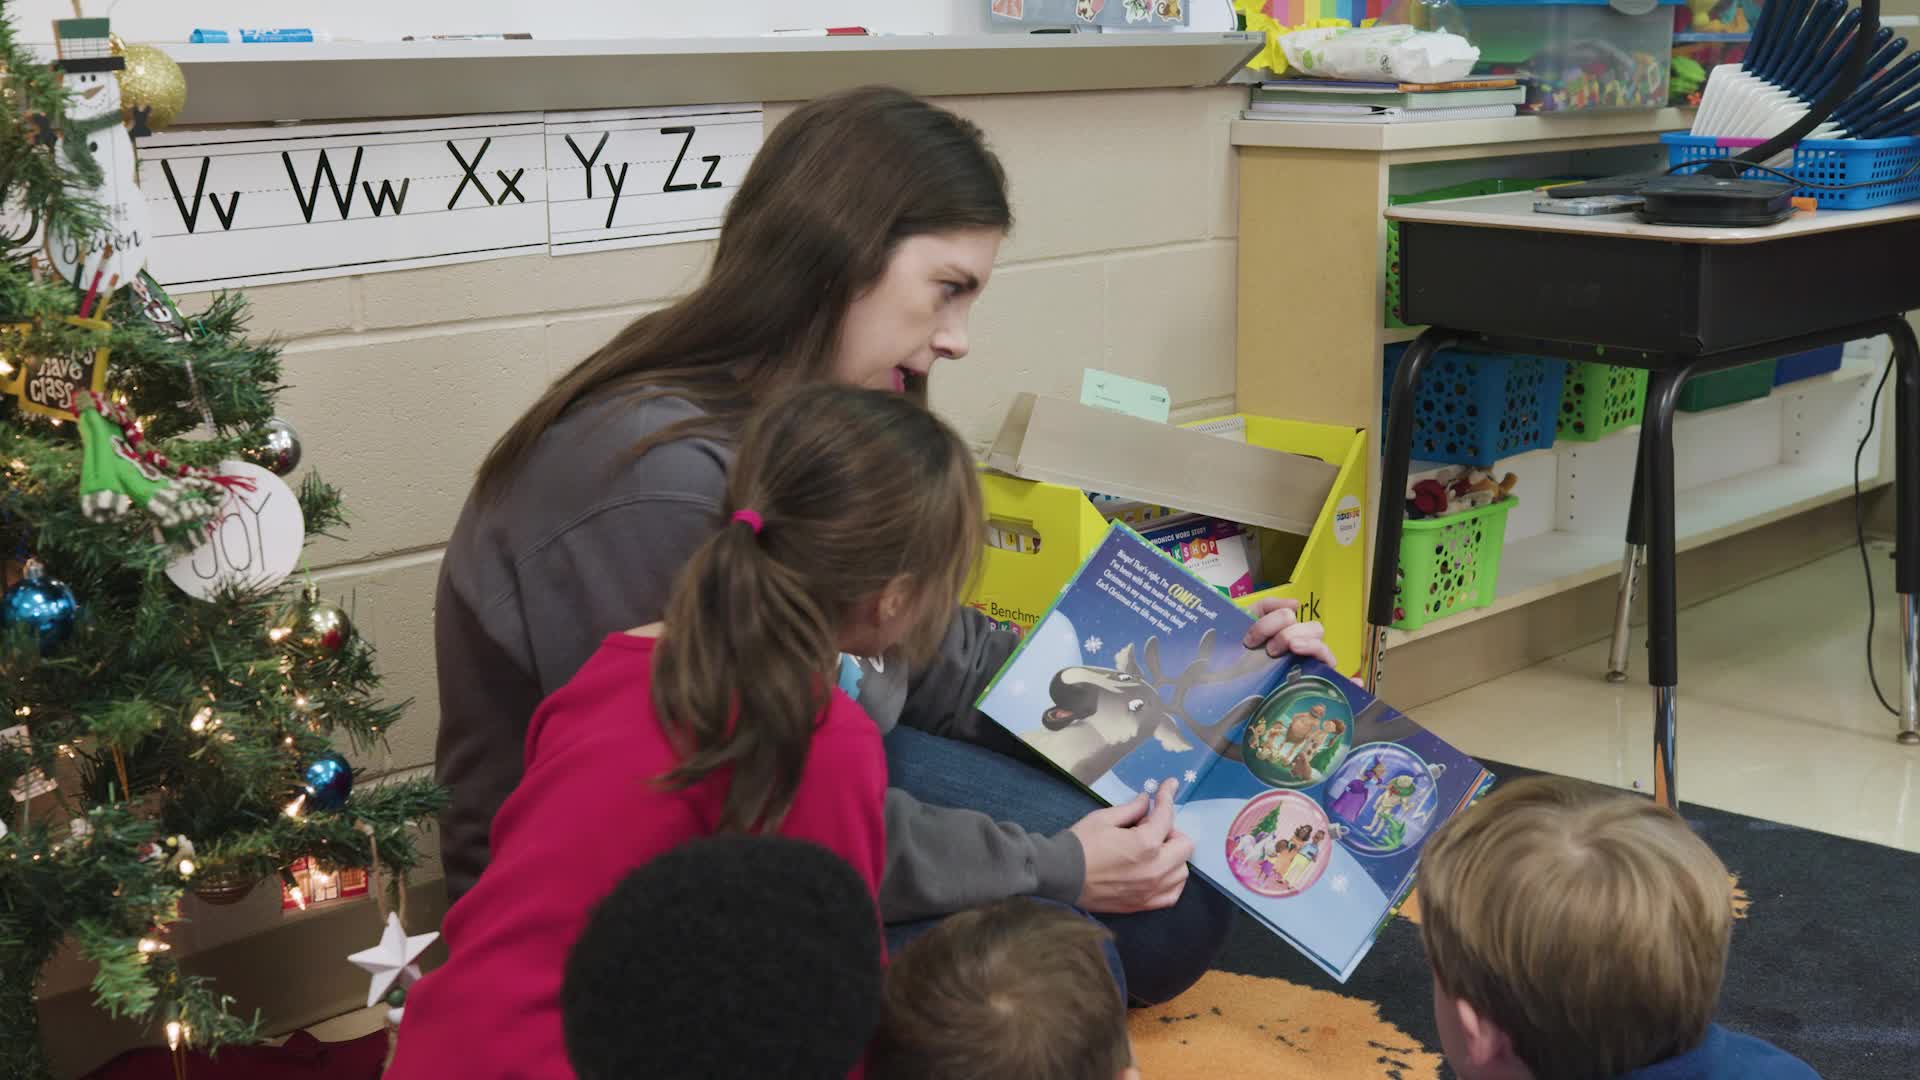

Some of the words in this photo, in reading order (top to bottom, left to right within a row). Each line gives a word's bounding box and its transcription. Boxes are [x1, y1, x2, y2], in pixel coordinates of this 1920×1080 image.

[161, 156, 240, 233] Vv
[282, 145, 409, 223] Ww
[447, 136, 525, 209] Xx
[565, 131, 629, 228] Yy
[660, 126, 722, 192] Zz
[192, 492, 272, 580] JOY
[1175, 531, 1191, 540] WORD
[1191, 527, 1207, 536] STUDY
[1095, 578, 1110, 592] Each
[1107, 586, 1132, 607] Christmas
[1129, 601, 1141, 613] Eve
[1148, 615, 1159, 626] my
[1103, 568, 1128, 590] Christmas
[1125, 584, 1132, 593] is
[1129, 588, 1140, 599] my
[1137, 593, 1153, 606] most
[1150, 600, 1171, 619] favorite
[1109, 558, 1121, 570] I've
[1118, 564, 1133, 579] been
[1131, 574, 1144, 586] with
[1142, 581, 1153, 592] the
[1163, 595, 1178, 609] from
[1175, 604, 1186, 614] the
[1167, 583, 1202, 610] COMET
[1296, 592, 1320, 623] rk
